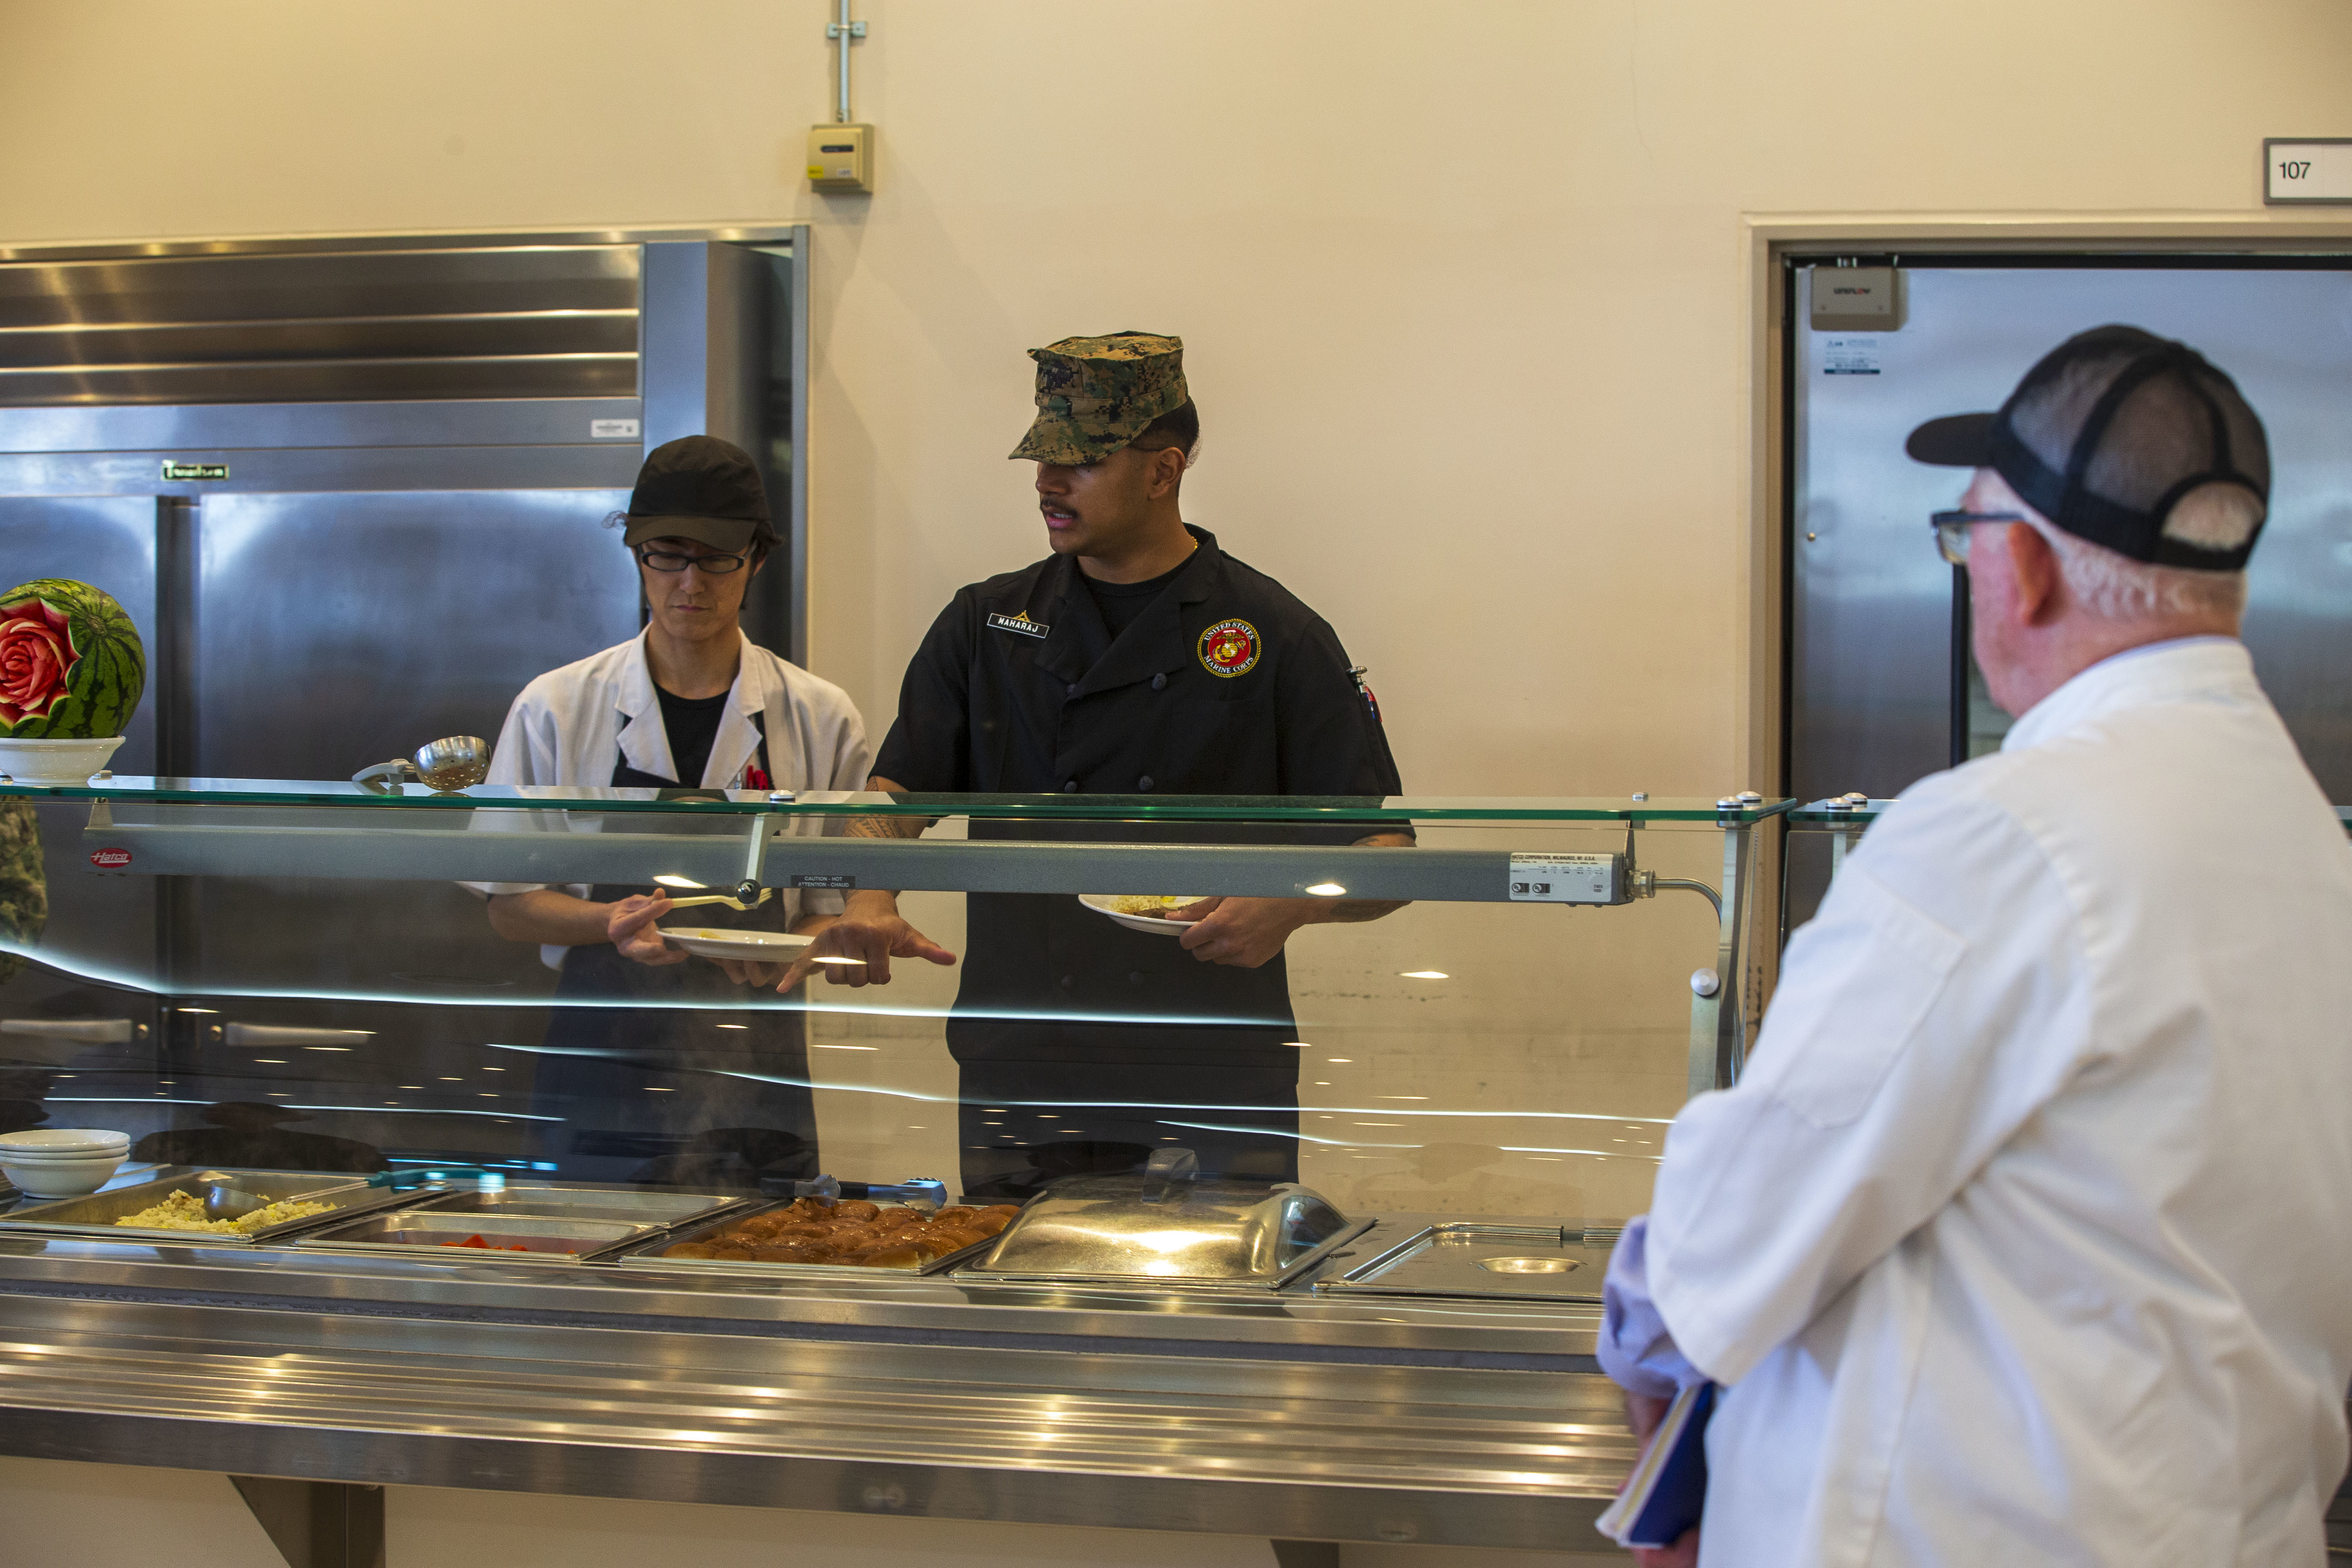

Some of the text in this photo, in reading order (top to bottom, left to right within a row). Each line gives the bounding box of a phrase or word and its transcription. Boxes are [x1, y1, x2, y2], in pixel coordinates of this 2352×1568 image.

[2279, 162, 2311, 179] 107
[998, 617, 1039, 632] MAHARAJ
[1204, 622, 1255, 641] UNITED STATES
[1204, 655, 1254, 674] MARINE CORPS
[91, 853, 129, 863] Hatco
